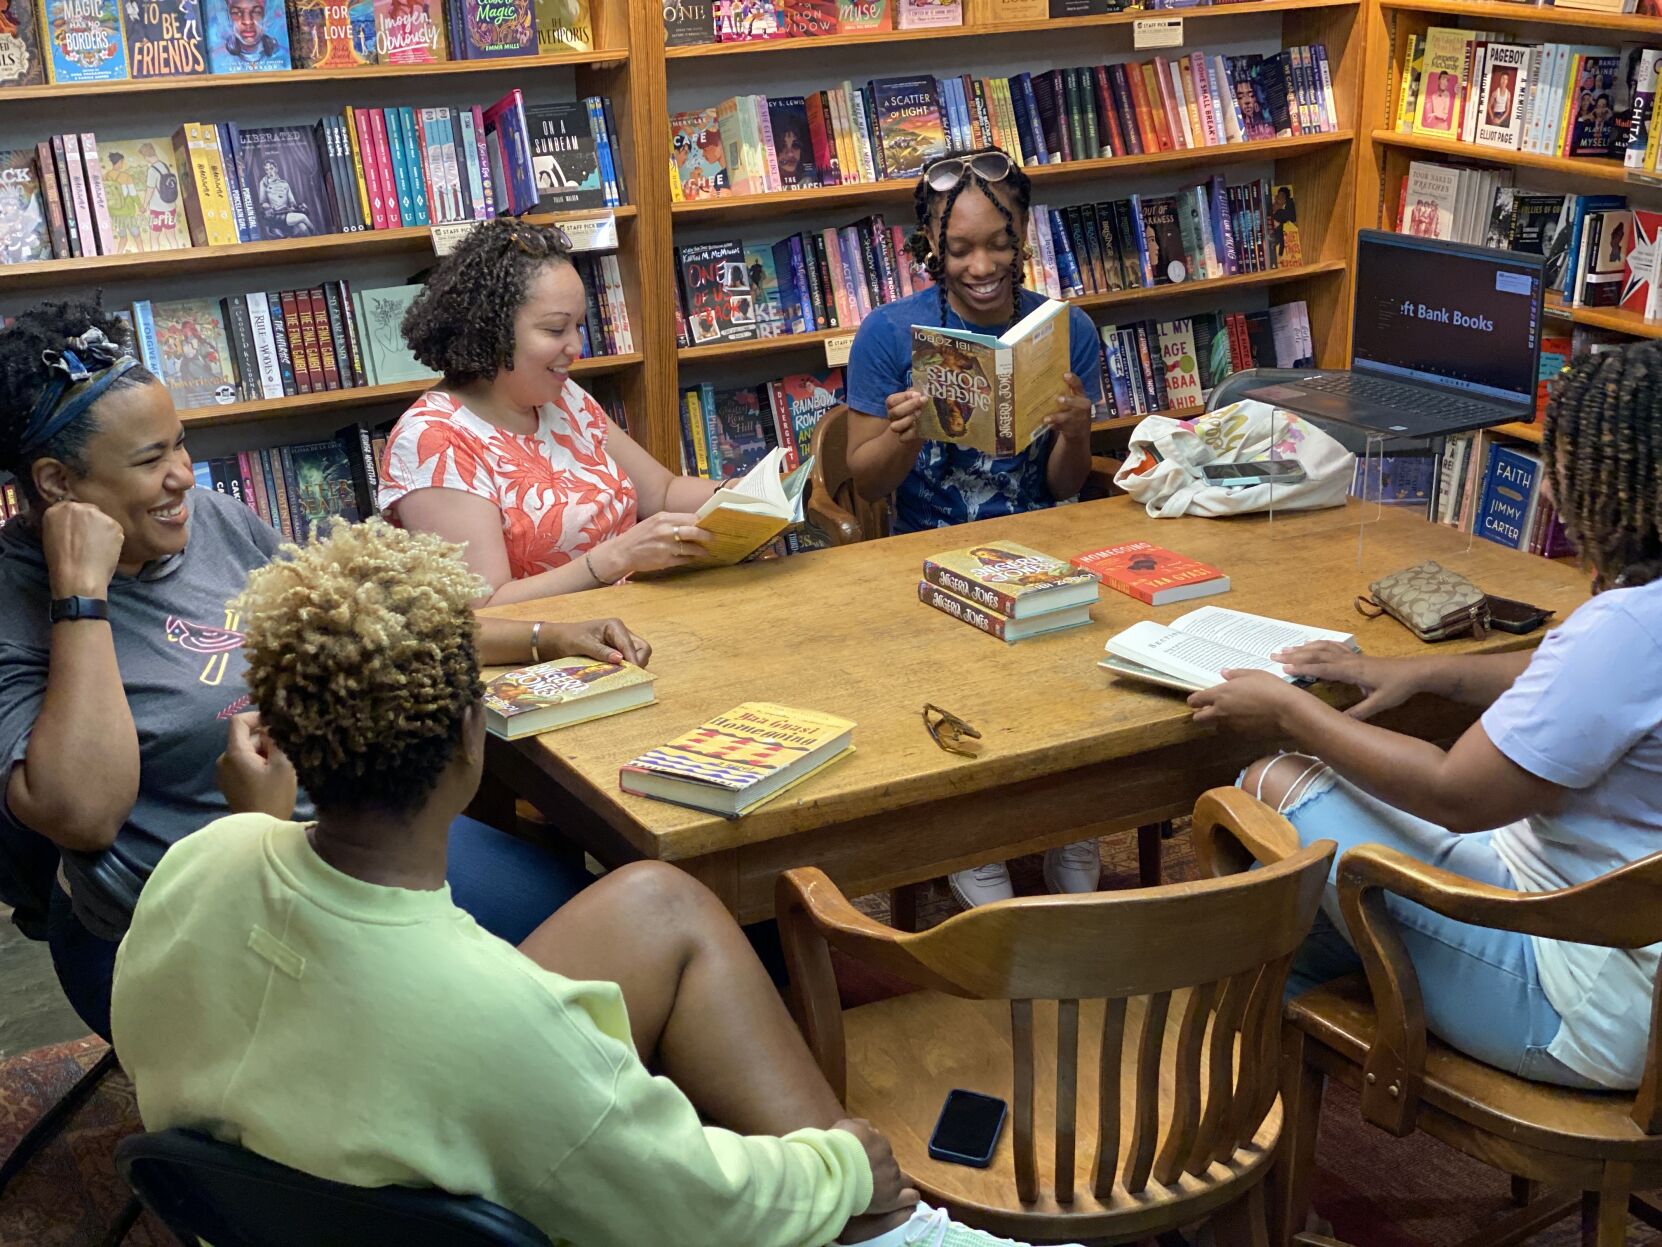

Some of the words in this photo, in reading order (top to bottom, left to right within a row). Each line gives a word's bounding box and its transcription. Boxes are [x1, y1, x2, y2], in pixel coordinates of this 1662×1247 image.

[64, 0, 104, 20] MAGIC
[143, 2, 159, 24] TO
[324, 6, 348, 20] FOR
[476, 6, 517, 25] Magic
[162, 13, 182, 40] BE
[324, 25, 354, 40] LOVE
[66, 32, 109, 50] BORDERS
[376, 24, 440, 54] Obviously
[133, 38, 204, 76] FRIENDS
[1490, 48, 1524, 65] PAGEBOY
[1196, 62, 1206, 83] SOME
[1201, 84, 1211, 109] SMALL
[890, 94, 930, 105] SCATTER
[1515, 86, 1526, 121] MEMOIR
[901, 106, 928, 117] LIGHT
[1628, 96, 1644, 144] CHITA
[240, 132, 300, 144] LIBERATED
[542, 120, 554, 136] ON
[560, 120, 566, 134] A
[1480, 128, 1498, 142] ELLIOT
[1498, 132, 1513, 144] PAGE
[534, 136, 578, 154] SUNBEAM
[1158, 206, 1168, 214] OF
[1224, 232, 1237, 260] WAKING
[688, 259, 726, 288] ONE
[842, 261, 853, 281] ACT
[845, 281, 858, 310] COOL
[286, 313, 298, 326] THE
[300, 312, 312, 324] THE
[315, 310, 326, 323] THE
[1172, 318, 1190, 335] MY
[1418, 304, 1450, 324] Bank
[1452, 310, 1494, 332] Books
[288, 327, 302, 348] FINAL
[302, 326, 316, 346] FINAL
[317, 325, 331, 345] FINAL
[1238, 320, 1247, 337] THE
[914, 330, 952, 348] ZOBOI
[956, 342, 970, 352] IBI
[1241, 338, 1250, 360] HATE
[321, 346, 336, 372] GAMBIT
[1163, 342, 1188, 357] AGE
[292, 349, 307, 374] GAMBIT
[307, 347, 321, 373] GAMBIT
[928, 364, 988, 392] JONES
[792, 389, 836, 412] RAINBOW
[1107, 392, 1114, 404] ME
[1169, 395, 1198, 410] AHIR
[707, 415, 718, 434] Plus
[777, 391, 794, 460] DIVERGENT
[710, 435, 720, 456] One
[1496, 462, 1532, 488] FAITH
[1490, 498, 1522, 520] JIMMY
[1485, 516, 1520, 541] CARTER
[1080, 542, 1152, 564] HOMEGOING
[1148, 576, 1172, 588] YAA
[1176, 569, 1212, 582] GYASI
[938, 571, 970, 595] NIGERIA
[971, 586, 999, 609] JONES
[932, 592, 962, 618] NIGERIA
[963, 608, 989, 630] JONES
[710, 716, 819, 746] Homegoing
[738, 712, 768, 725] Yaa
[770, 719, 820, 736] Gyasi
